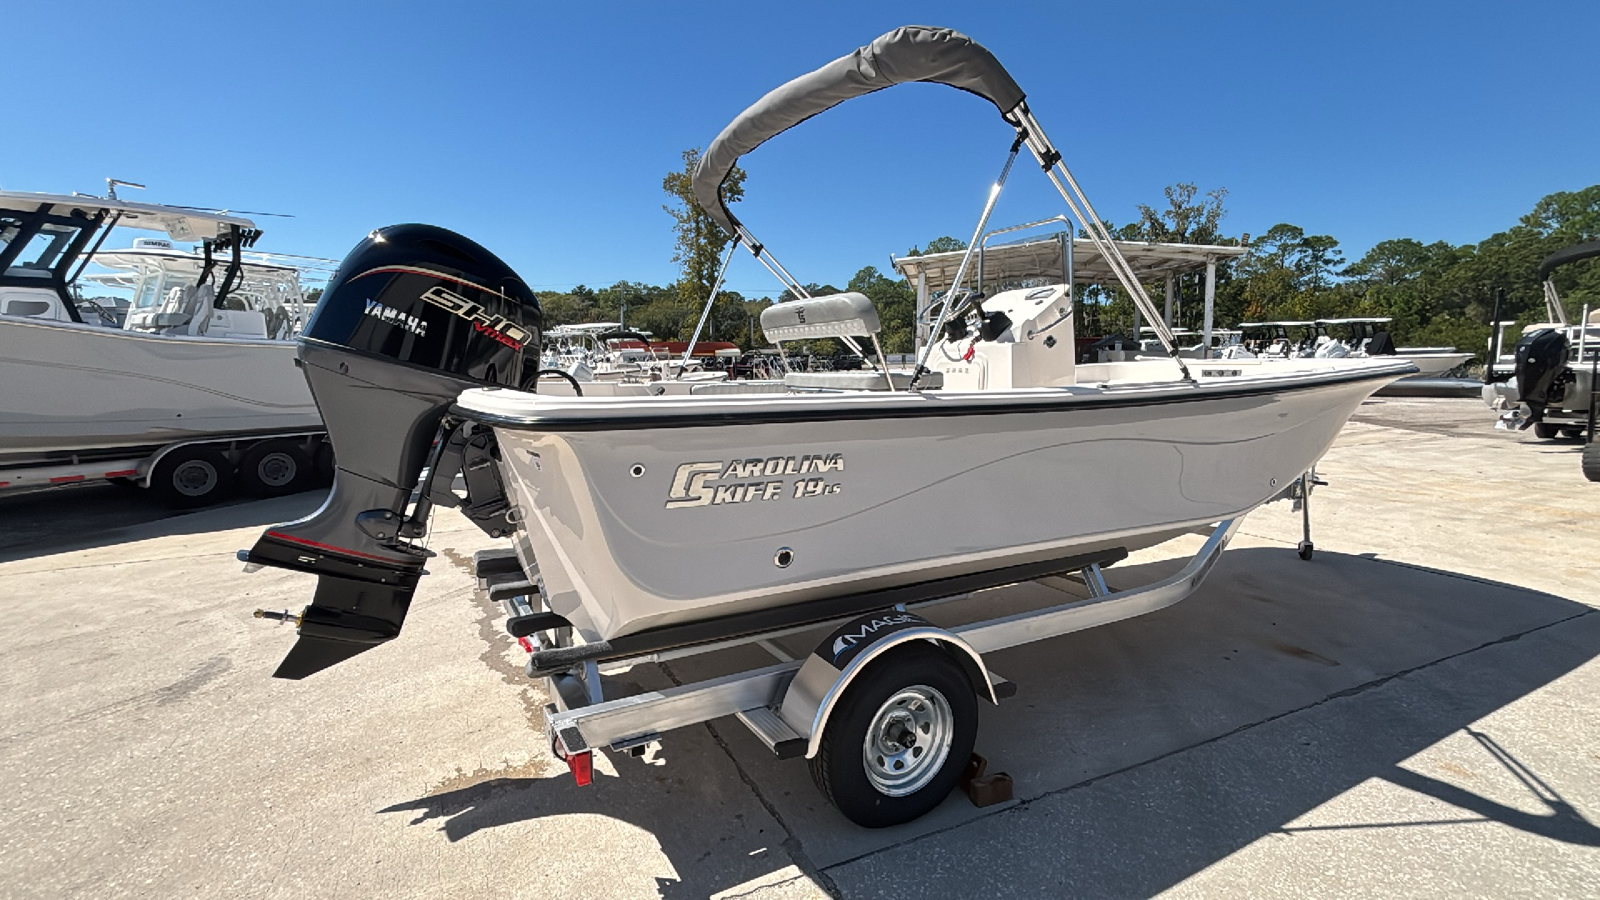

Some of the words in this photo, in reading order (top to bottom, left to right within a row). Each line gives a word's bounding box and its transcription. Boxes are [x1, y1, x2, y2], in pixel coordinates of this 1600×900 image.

[364, 298, 428, 338] YAMAHA
[420, 286, 532, 346] SHO
[669, 453, 845, 498] CAROLINA
